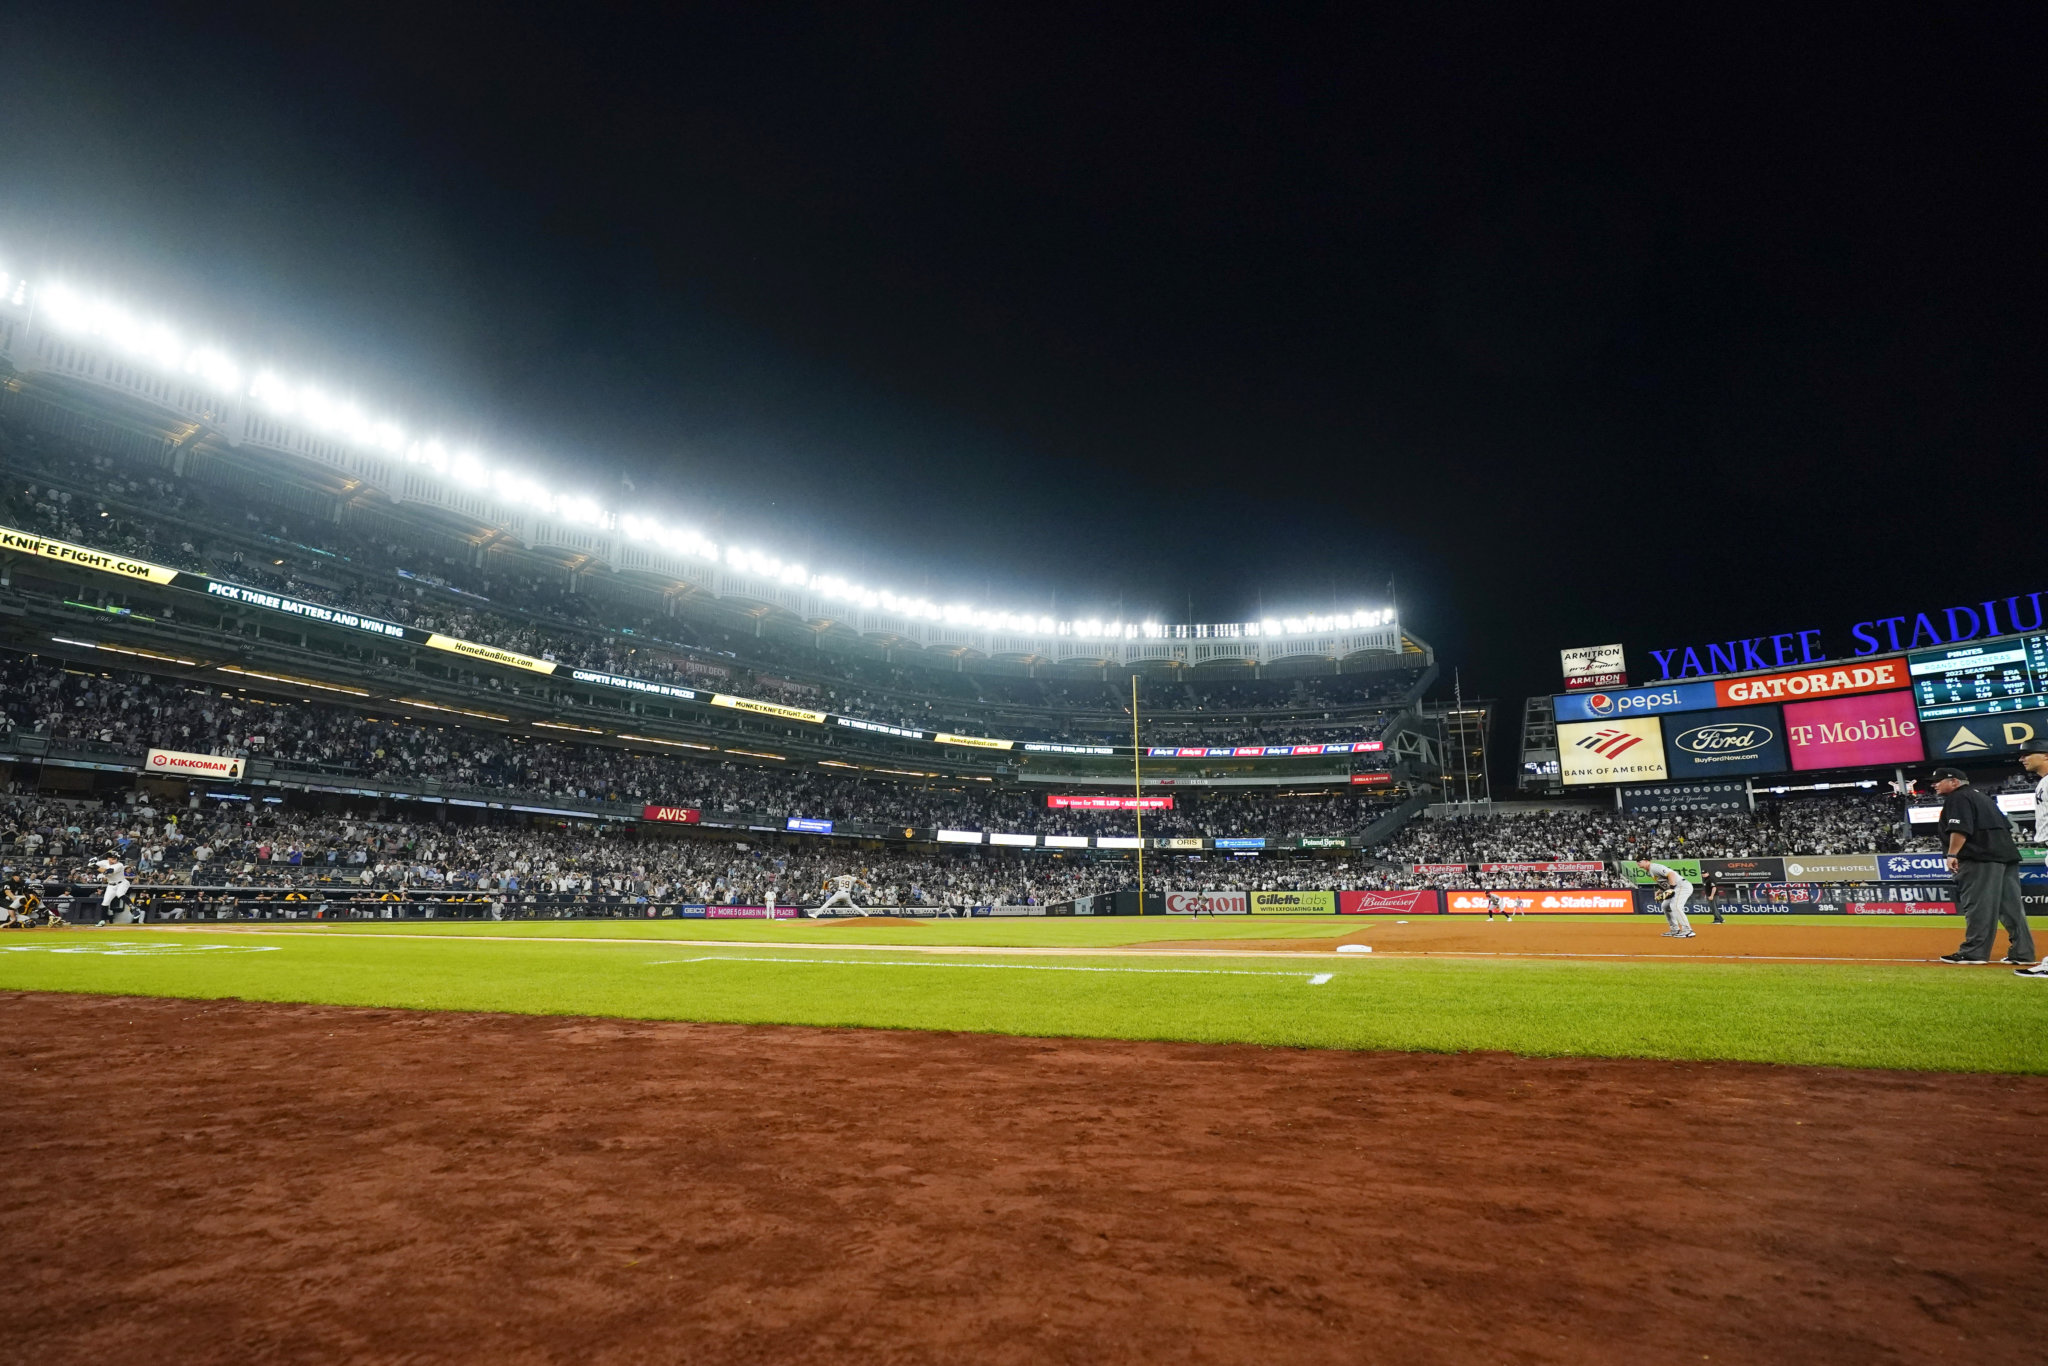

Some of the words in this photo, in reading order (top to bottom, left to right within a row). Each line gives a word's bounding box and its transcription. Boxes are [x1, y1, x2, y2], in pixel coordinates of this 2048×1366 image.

[208, 582, 239, 599] PICK
[241, 590, 281, 609] THREE
[281, 599, 332, 621] BATTERS
[332, 612, 359, 627] AND
[360, 618, 384, 633] WIN
[385, 625, 404, 638] BIG
[1852, 591, 2048, 657] STADIU
[455, 642, 533, 668] HomeRunBlast.com
[1565, 648, 1620, 660] ARMITRON
[1648, 629, 1827, 680] YANKEE
[1947, 648, 1983, 658] PIRATES
[686, 661, 708, 674] PARTY
[708, 666, 726, 677] DECK
[1965, 666, 1995, 675] SEASON
[572, 670, 610, 687] COMPETE
[610, 677, 627, 688] FOR
[661, 686, 670, 695] IN
[670, 687, 694, 699] PRIZES
[1570, 674, 1620, 685] ARMITRON
[1728, 665, 1896, 701] GATORADE
[1617, 690, 1680, 713] pepsi
[735, 701, 816, 721] MONKEYKNIFEFIGHT.COM
[1923, 708, 1958, 717] PITCHING
[1817, 717, 1917, 745] Mobile
[2003, 722, 2035, 745] D
[1692, 727, 1755, 750] Ford
[169, 758, 227, 771] KIKKOMAN
[1694, 753, 1759, 763] BuyFordNow.com
[1564, 768, 1593, 777] BANK
[1612, 765, 1664, 774] AMERICA
[657, 808, 688, 821] AVIS
[1302, 838, 1324, 847] Poland
[1324, 839, 1346, 848] Spring
[1911, 858, 1950, 872] cou
[840, 880, 850, 888] 59
[1167, 894, 1246, 912] Canon
[1363, 897, 1414, 907] Budweiser
[1471, 896, 1534, 908] StaFam
[1693, 904, 1738, 913] StuHub
[1742, 904, 1789, 913] StubHub
[742, 908, 756, 916] BARS
[756, 908, 761, 916] IN
[777, 908, 794, 916] PLACES
